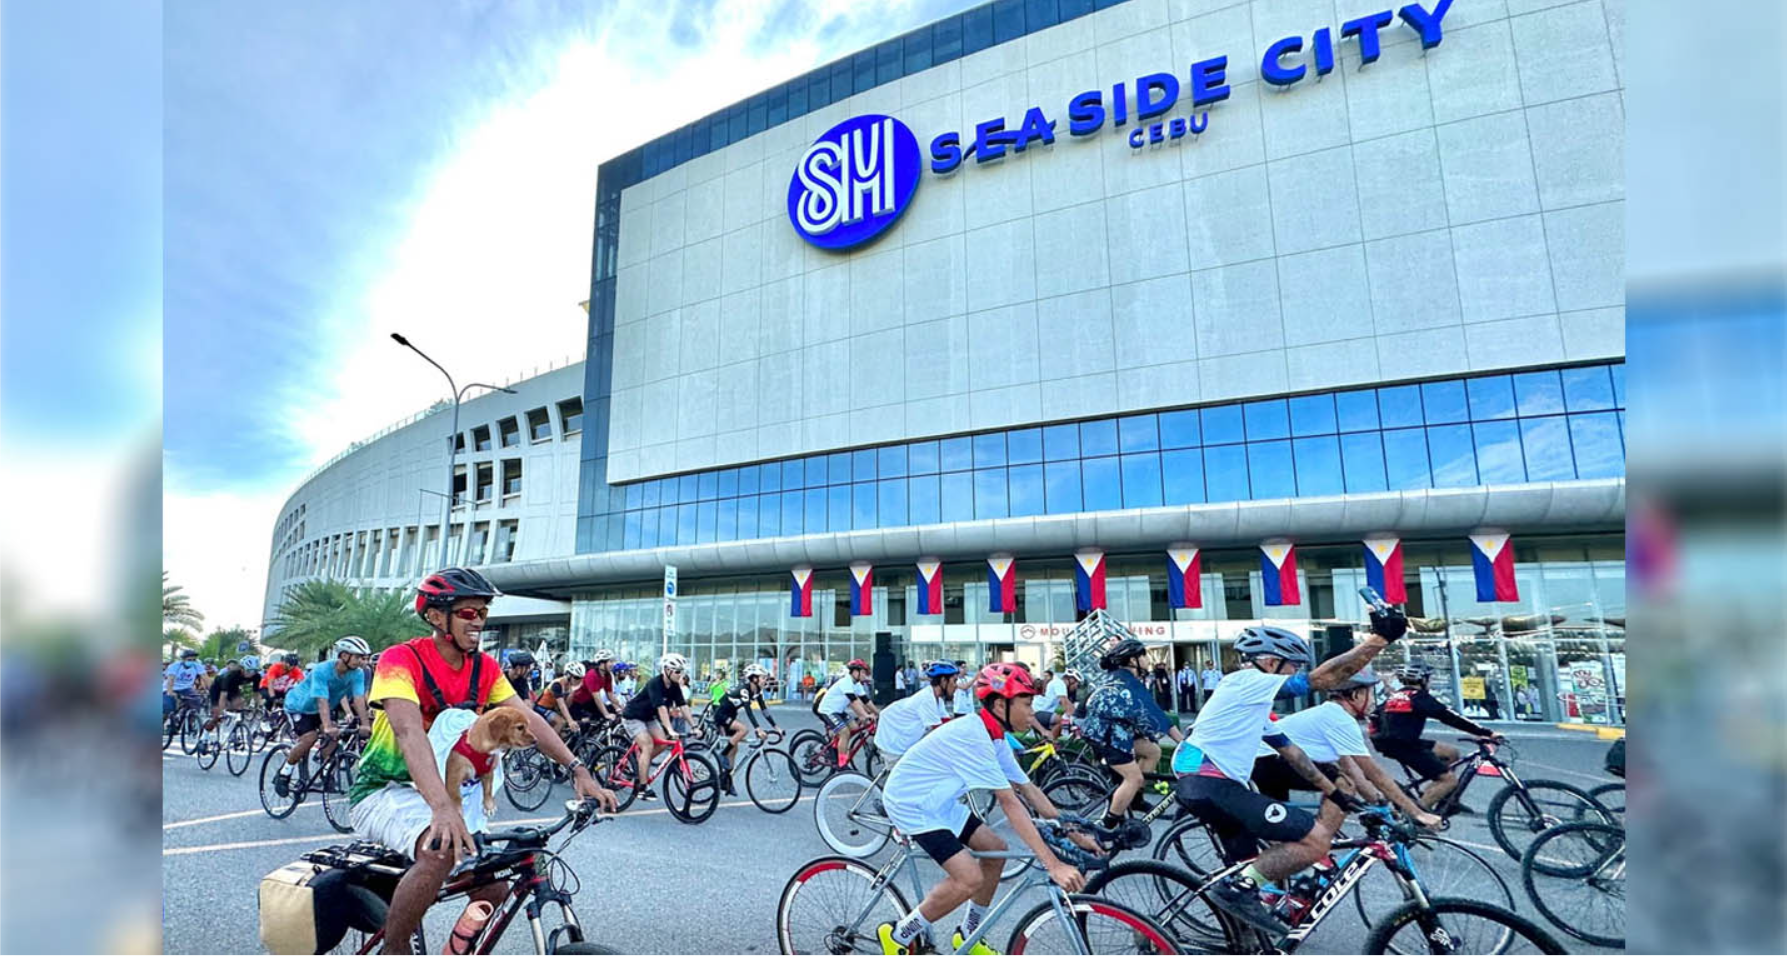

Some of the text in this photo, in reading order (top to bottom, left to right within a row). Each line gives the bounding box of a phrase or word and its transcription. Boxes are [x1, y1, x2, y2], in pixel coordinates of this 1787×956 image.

[1261, 0, 1452, 86] CITY
[1128, 111, 1209, 149] CEBU
[796, 118, 895, 235] SM
